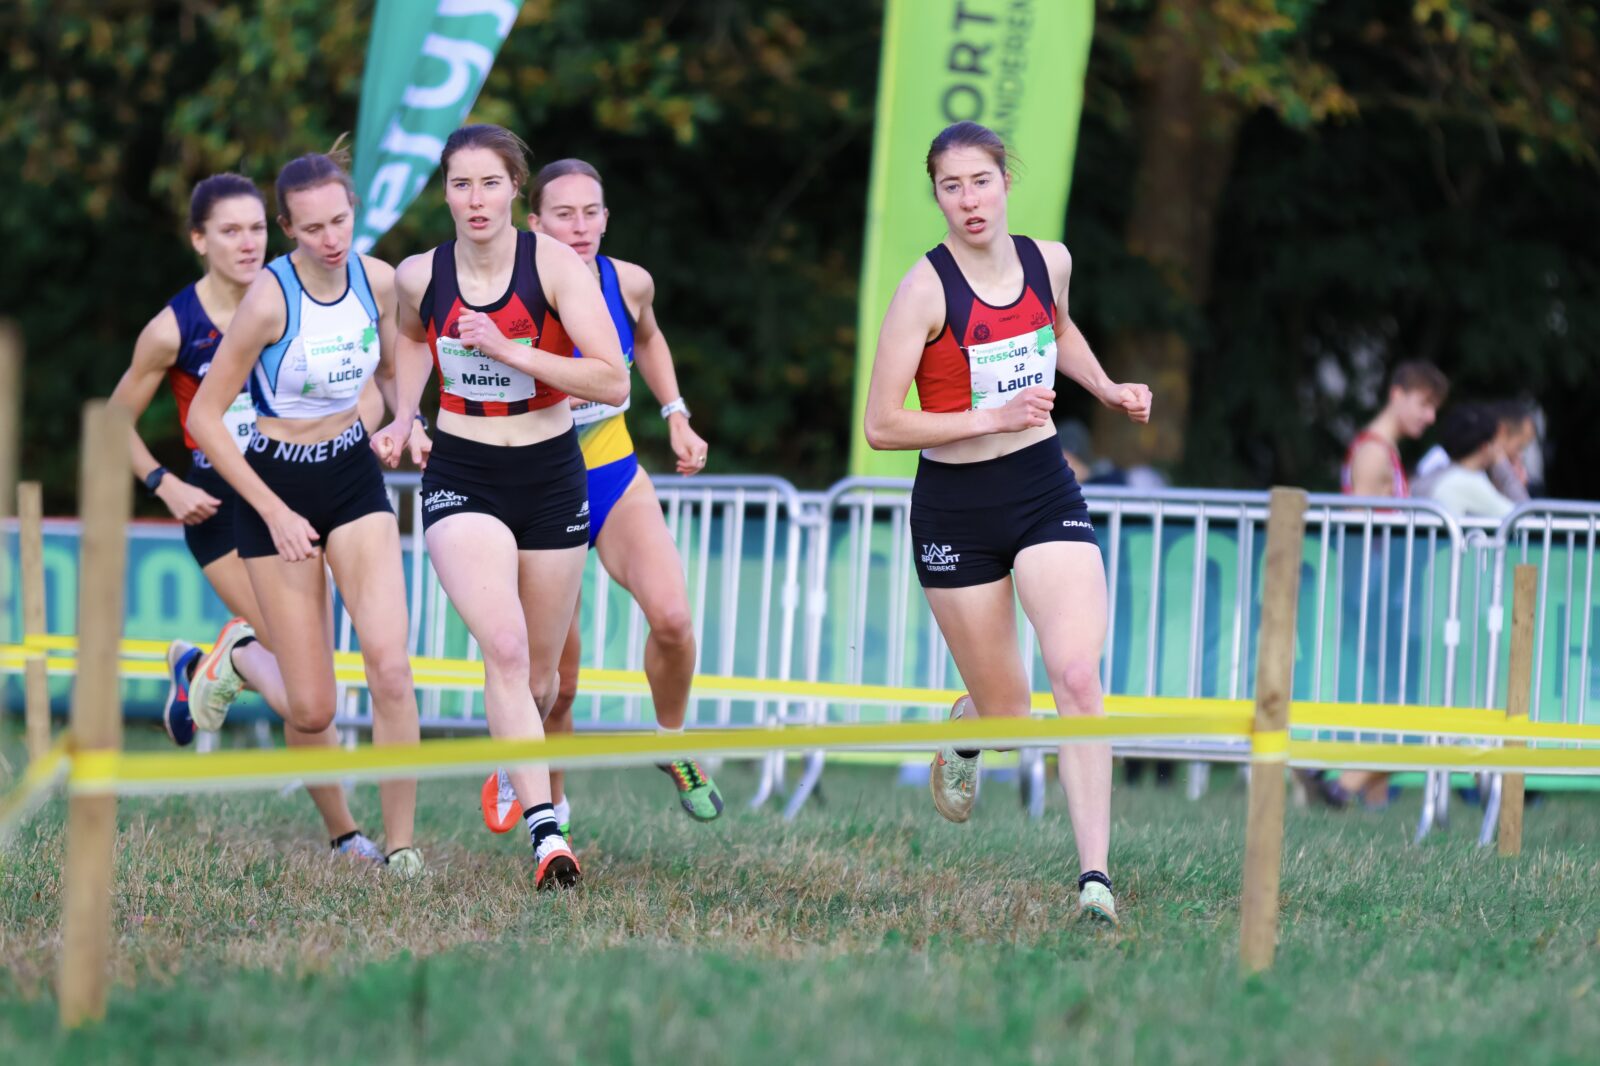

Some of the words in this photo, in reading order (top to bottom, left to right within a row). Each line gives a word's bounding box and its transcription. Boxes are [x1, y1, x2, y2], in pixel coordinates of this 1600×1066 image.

[940, 0, 995, 122] ORT
[442, 346, 490, 359] crosscu
[976, 346, 1029, 365] crosscup
[341, 357, 352, 366] 14
[479, 363, 491, 372] 11
[1014, 362, 1026, 373] 12
[328, 365, 363, 384] Lucie
[461, 372, 511, 387] Marie
[997, 371, 1044, 393] Laure
[273, 440, 329, 464] NIKE
[331, 420, 363, 458] PRO
[427, 500, 463, 513] LEBBEKE
[922, 543, 952, 556] TAP
